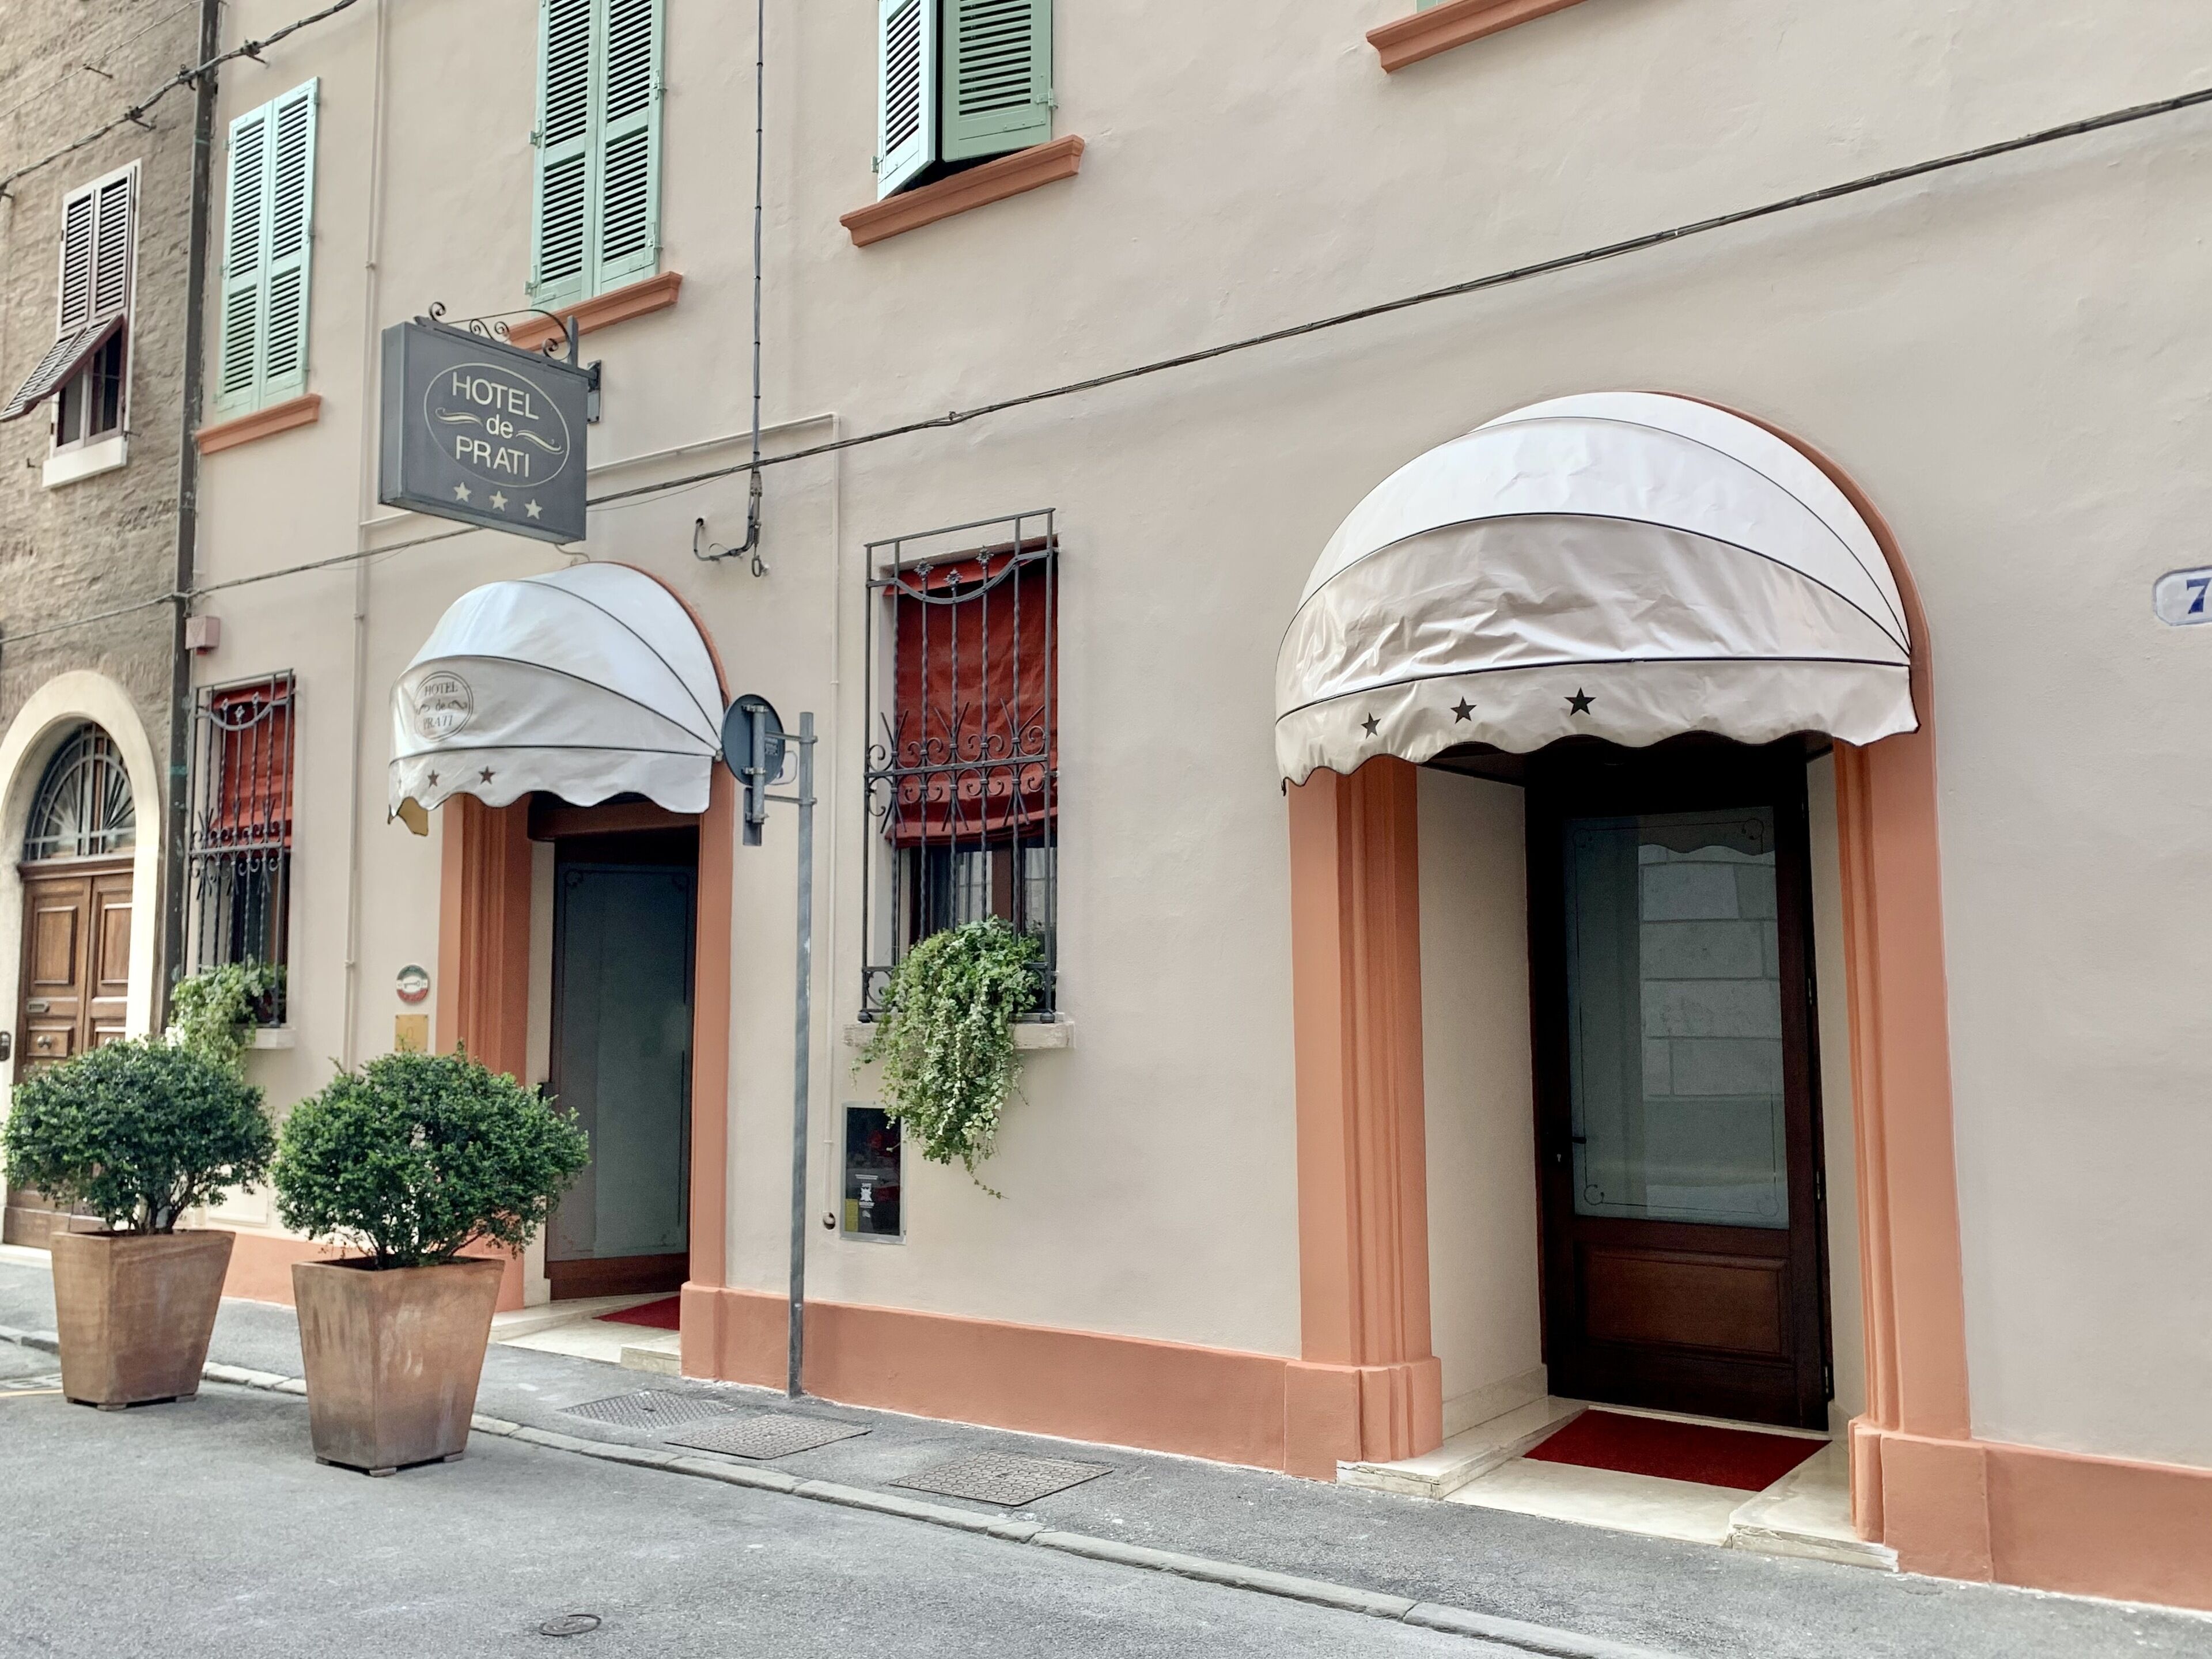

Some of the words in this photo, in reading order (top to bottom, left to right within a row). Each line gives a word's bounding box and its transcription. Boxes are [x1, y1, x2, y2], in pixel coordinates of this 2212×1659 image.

[452, 372, 539, 421] HOTEL
[486, 414, 514, 439] de
[456, 435, 529, 478] PRATI
[425, 681, 459, 696] HOTEL
[435, 699, 445, 711] de
[423, 715, 453, 729] PRATI
